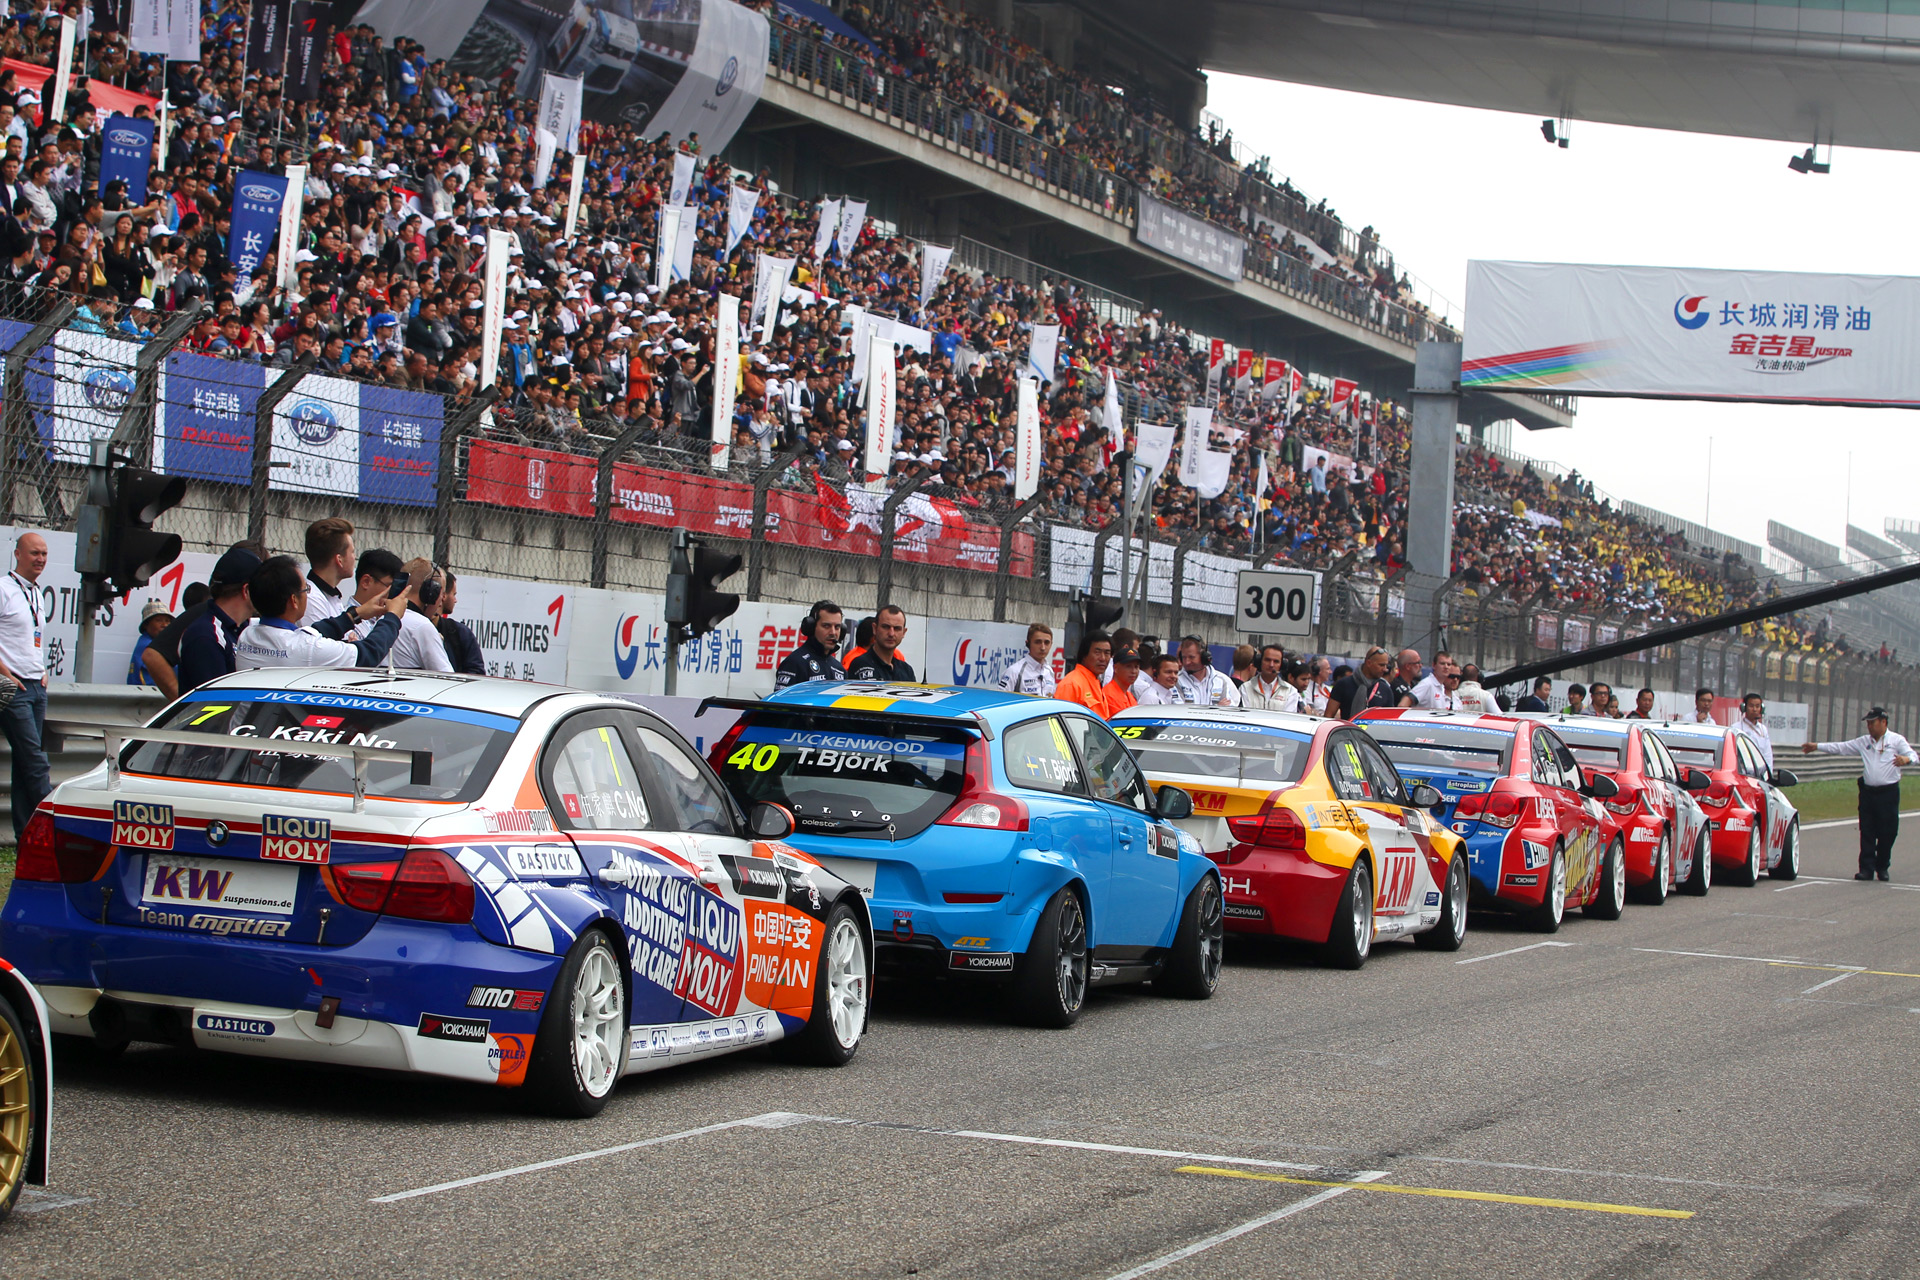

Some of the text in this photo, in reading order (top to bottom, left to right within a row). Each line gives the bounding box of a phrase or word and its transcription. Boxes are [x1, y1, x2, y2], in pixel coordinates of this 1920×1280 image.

[264, 5, 277, 53] KUMHO TIRES
[303, 37, 314, 64] KUMHO
[114, 131, 142, 146] Ford
[246, 187, 275, 201] Ford
[844, 213, 853, 232] Polo
[235, 231, 262, 295] 长安福
[1719, 301, 1871, 331] 长城润滑油
[1729, 333, 1815, 359] 金吉星
[1812, 347, 1853, 359] JUSTAR
[719, 357, 728, 421] HONDA
[298, 404, 330, 439] Ford
[877, 366, 888, 454] SPIRIOR
[181, 426, 251, 453] RACING
[372, 455, 433, 477] RACING
[619, 488, 675, 517] HONDA
[1245, 585, 1306, 622] 300
[511, 622, 549, 653] TIRES
[643, 623, 742, 674] 长润滑油
[756, 625, 807, 670] 金吉
[190, 705, 232, 726] 7
[255, 691, 434, 715] JVCKENWOOD
[230, 725, 398, 750] C. Kaki Ng
[1152, 719, 1262, 733] JVCKENWOOD
[784, 732, 925, 754] JVCKENWOOD
[1155, 734, 1237, 747] D.O'Young
[727, 743, 780, 771] 40
[797, 747, 892, 773] T.Björk
[1053, 759, 1079, 786] Björk
[116, 802, 170, 825] LIQUI
[1193, 792, 1227, 810] KM
[115, 824, 172, 847] MOLY
[265, 816, 328, 839] LIQUI
[264, 838, 328, 861] MOLY
[517, 852, 574, 871] BASTUCK
[151, 865, 234, 902] KW
[611, 849, 687, 917] MOTOR OILS
[748, 868, 779, 887] YOKOHAMA
[1376, 856, 1416, 908] LKM
[224, 895, 292, 908] suspensions.de
[893, 910, 912, 918] TOW
[137, 906, 185, 927] Team
[624, 893, 684, 955] ADDITIVES
[688, 890, 738, 958] LIQUI
[754, 909, 811, 950] 中国平安
[953, 936, 990, 946] ATS
[628, 934, 679, 992] CAR CARE
[747, 953, 810, 988] PING AN
[968, 957, 1011, 967] YOKOHAMA
[678, 946, 732, 1009] MOLY
[207, 1018, 266, 1033] BASTUCK
[441, 1022, 486, 1038] YOKOHAMA
[237, 1034, 266, 1043] Systems
[487, 1047, 526, 1061] DREXLER
